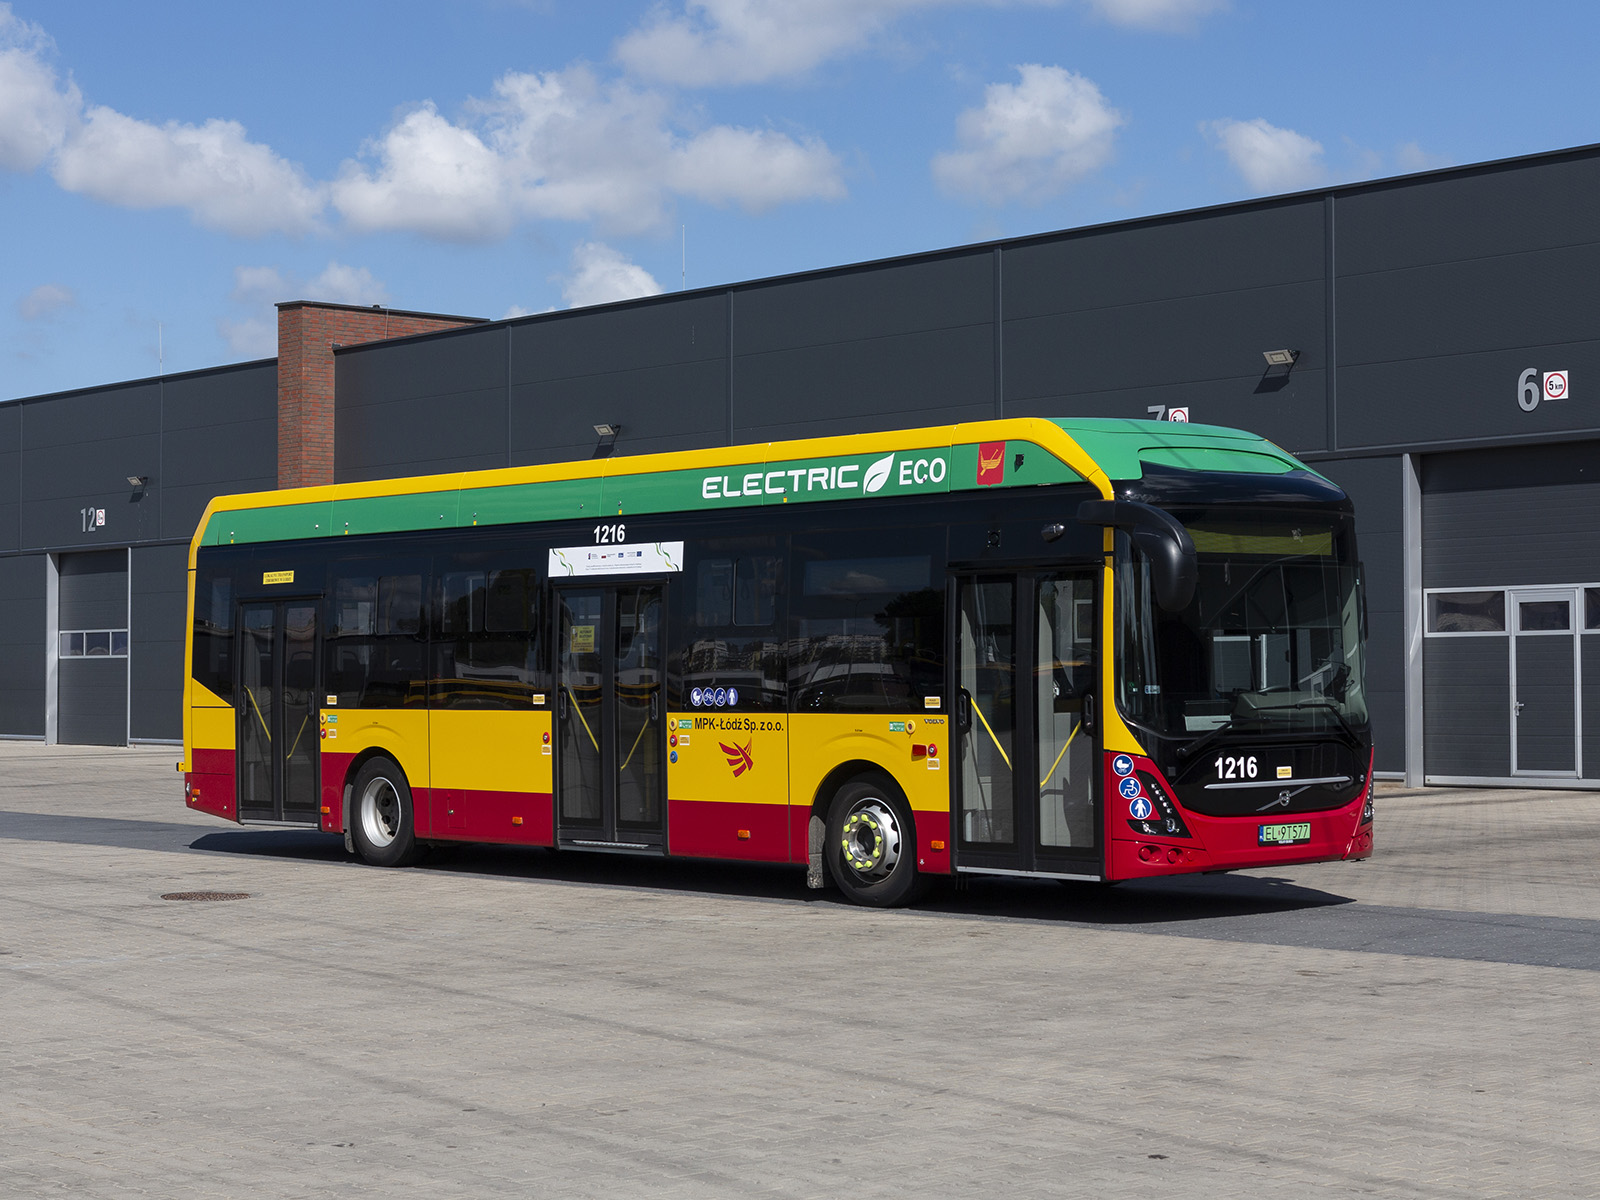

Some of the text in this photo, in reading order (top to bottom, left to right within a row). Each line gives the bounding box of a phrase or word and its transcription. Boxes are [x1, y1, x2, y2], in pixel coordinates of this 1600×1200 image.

[1518, 367, 1540, 412] 6
[1548, 380, 1554, 391] 5
[702, 457, 947, 499] ELECTRIC ECO
[80, 506, 96, 533] 12
[593, 523, 626, 544] 1216
[694, 717, 742, 731] MPK-Łódź
[743, 718, 759, 733] Sp.
[760, 721, 766, 731] z
[766, 721, 784, 731] o.o.
[1214, 756, 1258, 779] 1216
[1265, 825, 1309, 840] EL 9T577
